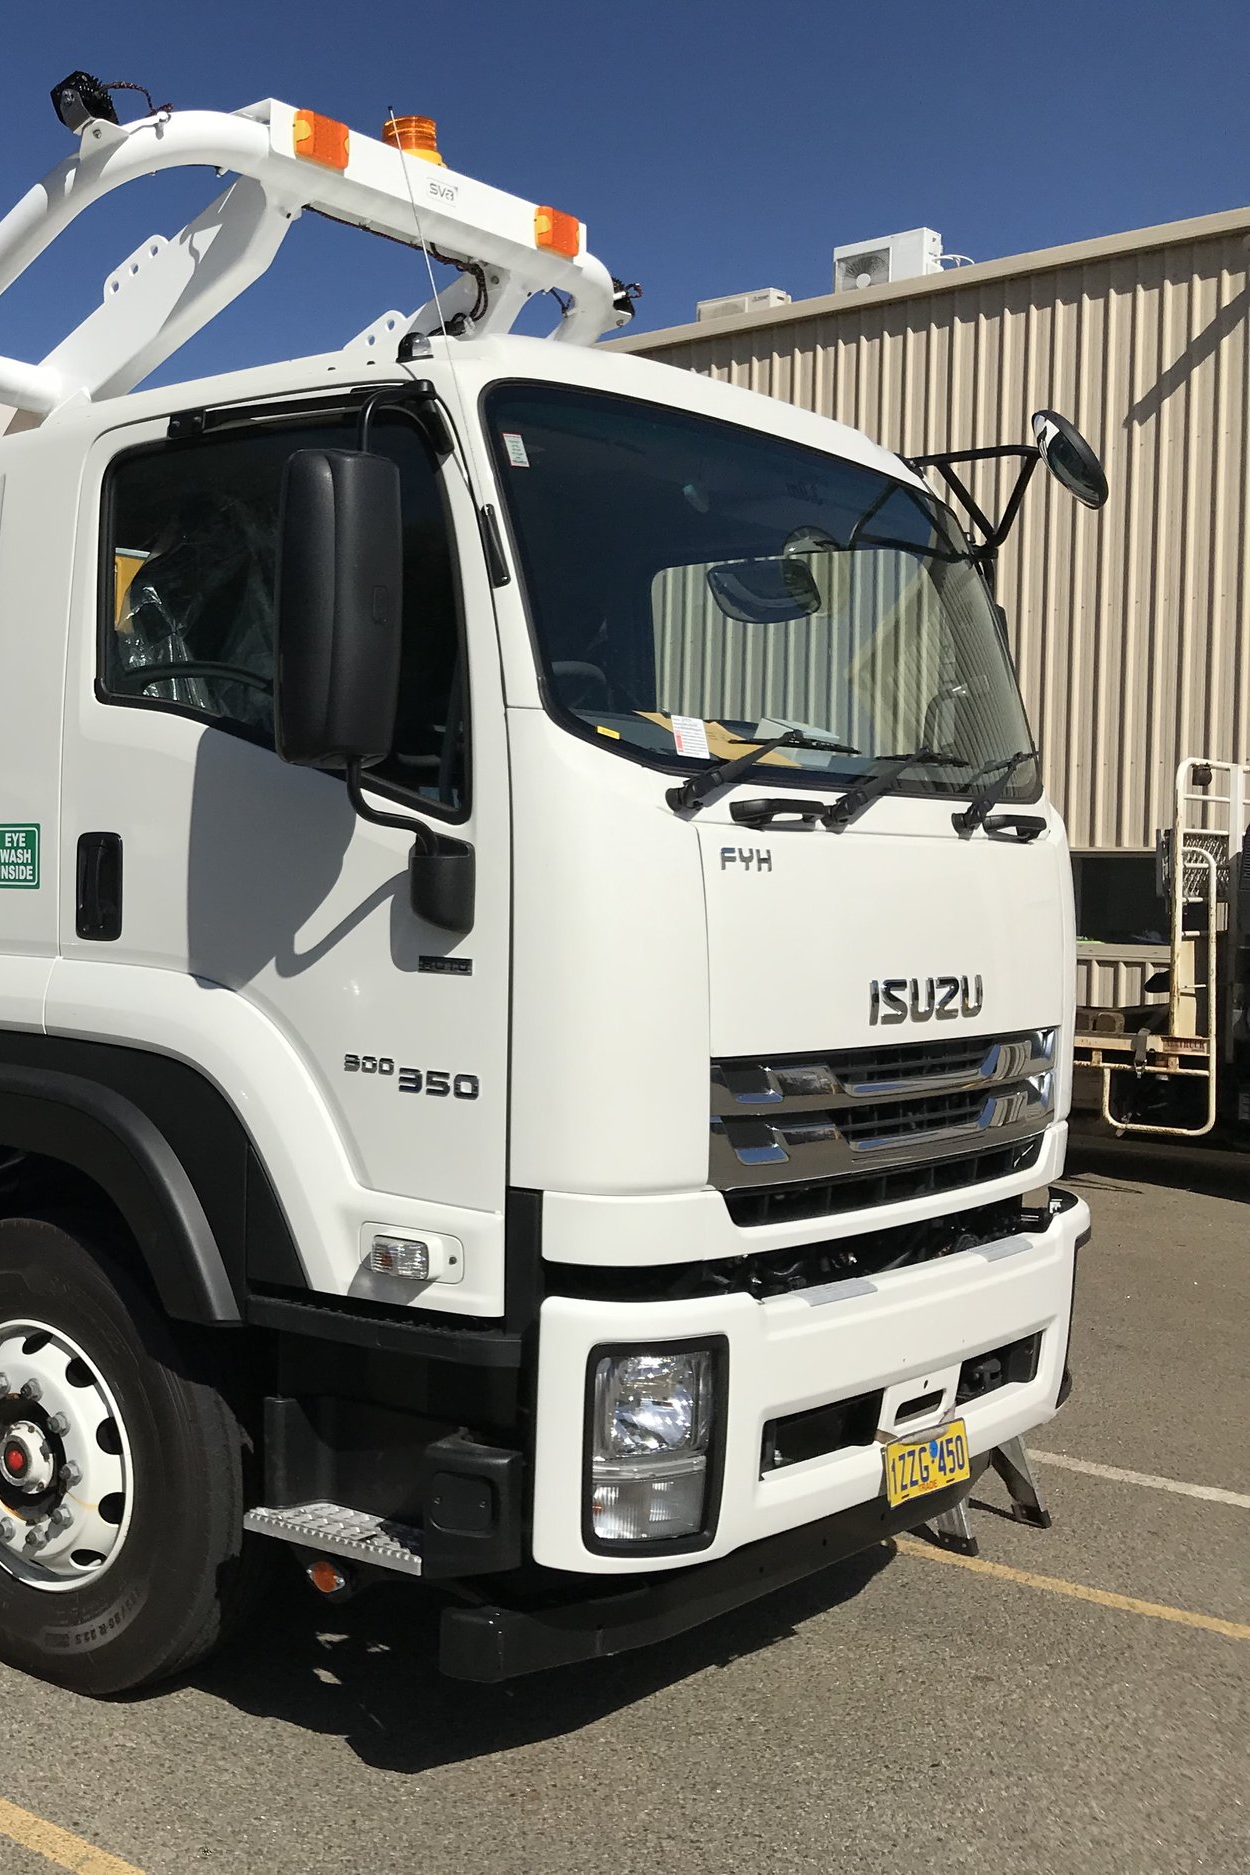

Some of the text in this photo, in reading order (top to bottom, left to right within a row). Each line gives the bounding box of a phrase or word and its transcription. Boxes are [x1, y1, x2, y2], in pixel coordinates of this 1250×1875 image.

[5, 832, 26, 847] EYE
[0, 848, 32, 864] WASH
[720, 847, 773, 873] FYH
[869, 974, 984, 1026] ISUZU
[398, 1067, 480, 1101] 350
[938, 1435, 965, 1476] 450
